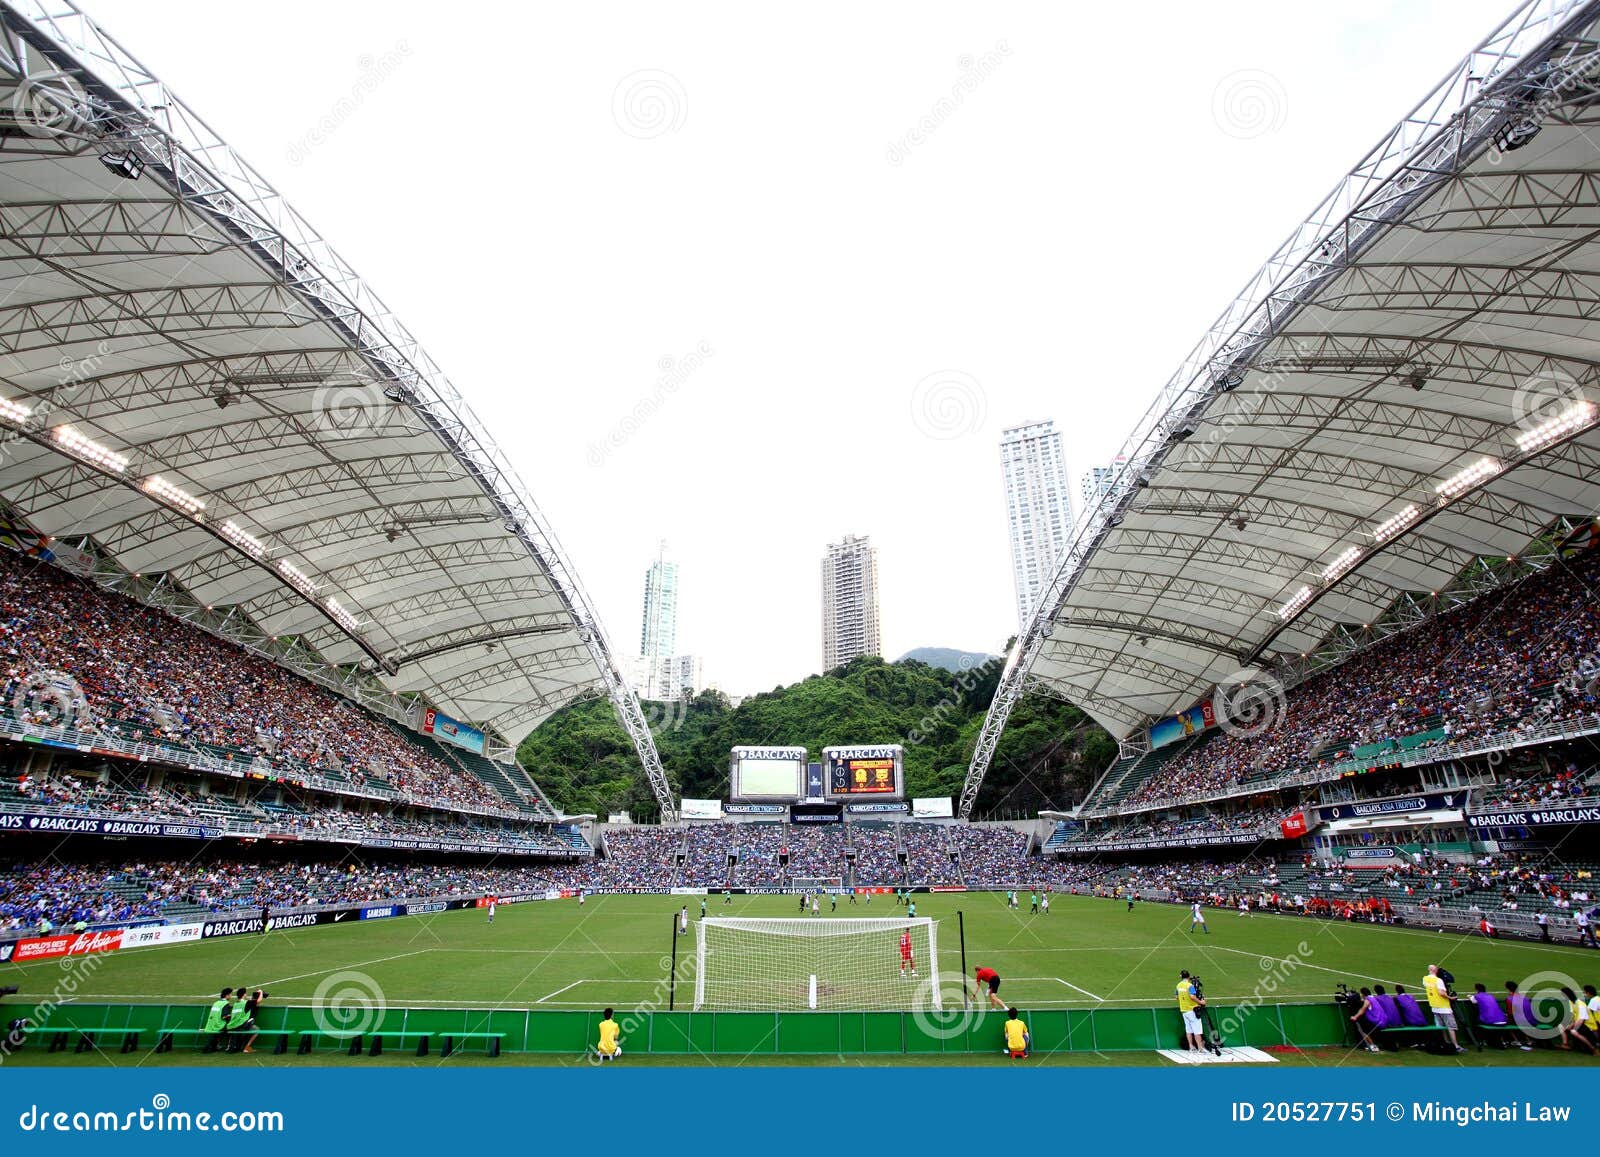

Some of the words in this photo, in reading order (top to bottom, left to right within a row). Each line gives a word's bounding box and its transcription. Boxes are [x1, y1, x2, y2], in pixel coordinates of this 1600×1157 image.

[749, 750, 801, 760] BARCLAYS
[840, 750, 893, 760] BARCLAYS
[1356, 803, 1381, 814] BARCLAYS
[1381, 802, 1395, 811] ASIA
[1395, 800, 1419, 809] TROPHY
[1478, 813, 1527, 826] BARCLAYS
[1540, 808, 1600, 823] BARCLAYS
[39, 817, 99, 831] BARCLAYS
[112, 822, 160, 834] BARCLAYS
[366, 908, 392, 918] SAMSUNG
[214, 919, 264, 936] BARCLAYS
[275, 913, 318, 928] BARCLAYS
[140, 932, 154, 940] FIFA
[154, 931, 160, 940] 12
[181, 928, 192, 936] FIFA
[52, 940, 68, 948] BEST
